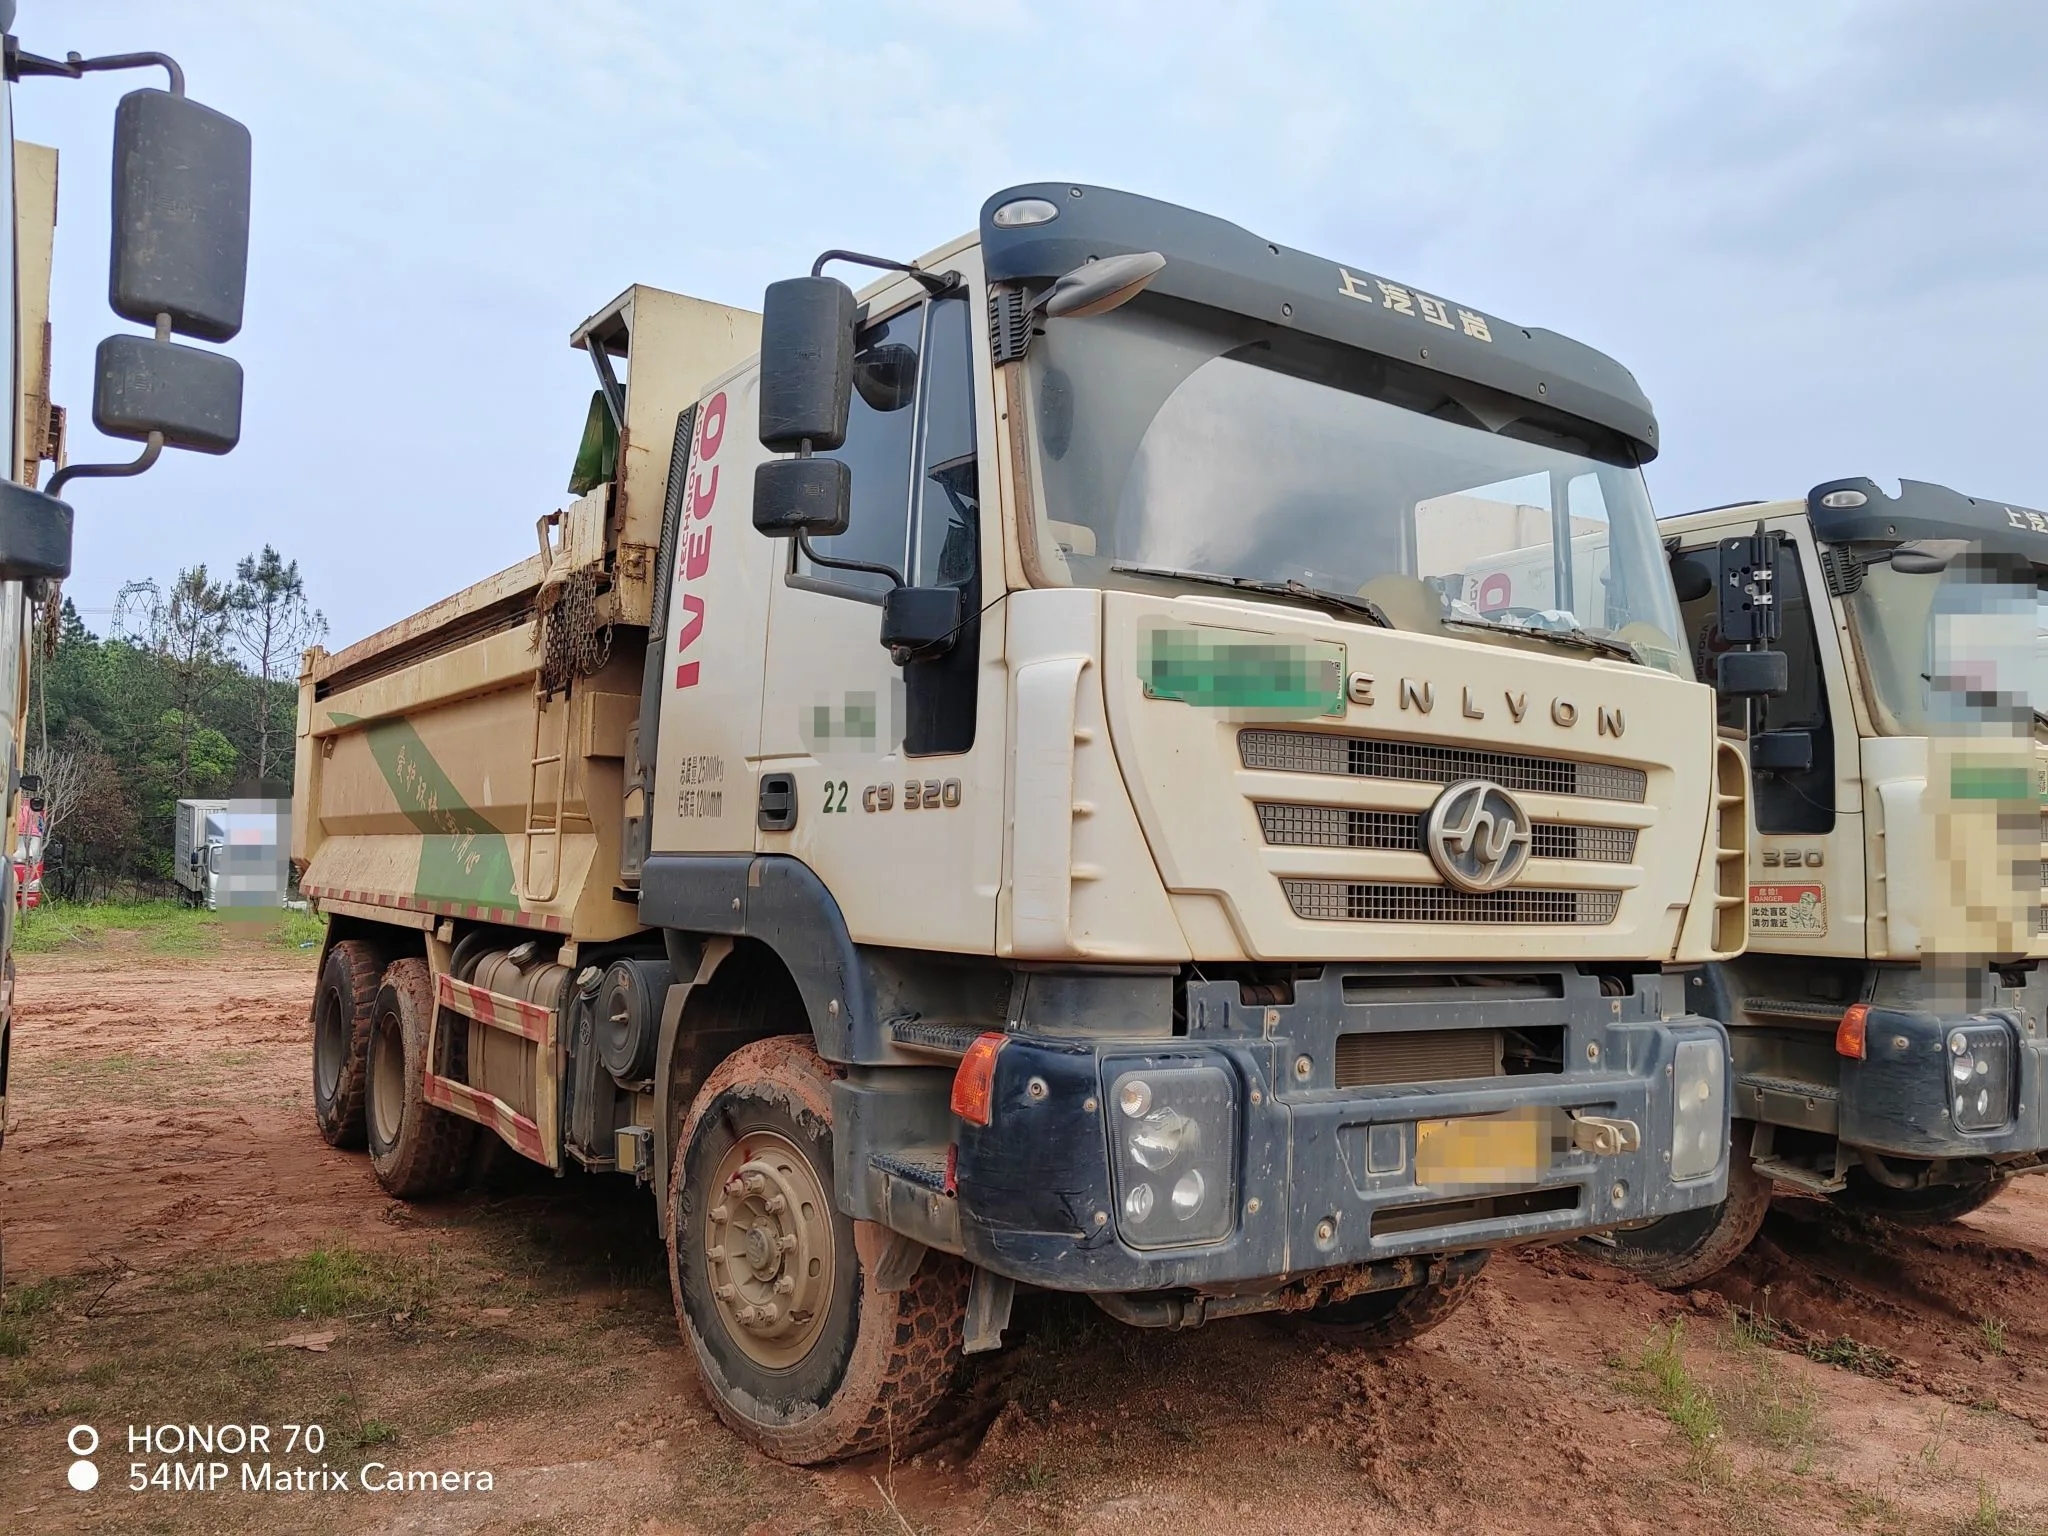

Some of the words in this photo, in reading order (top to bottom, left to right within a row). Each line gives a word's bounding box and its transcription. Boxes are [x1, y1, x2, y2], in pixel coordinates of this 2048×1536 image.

[1338, 267, 1493, 343] 上汽红岩
[678, 404, 704, 582] TECHNOLOGY
[2004, 506, 2048, 534] 上汽
[675, 391, 728, 690] IVECO
[1346, 671, 1627, 738] ENLYON
[822, 780, 849, 813] 22
[862, 781, 895, 813] C9
[903, 777, 962, 810] 320
[1762, 848, 1824, 868] 320
[1752, 907, 1787, 917] 此处盲区
[1752, 918, 1788, 928] 请勿靠近
